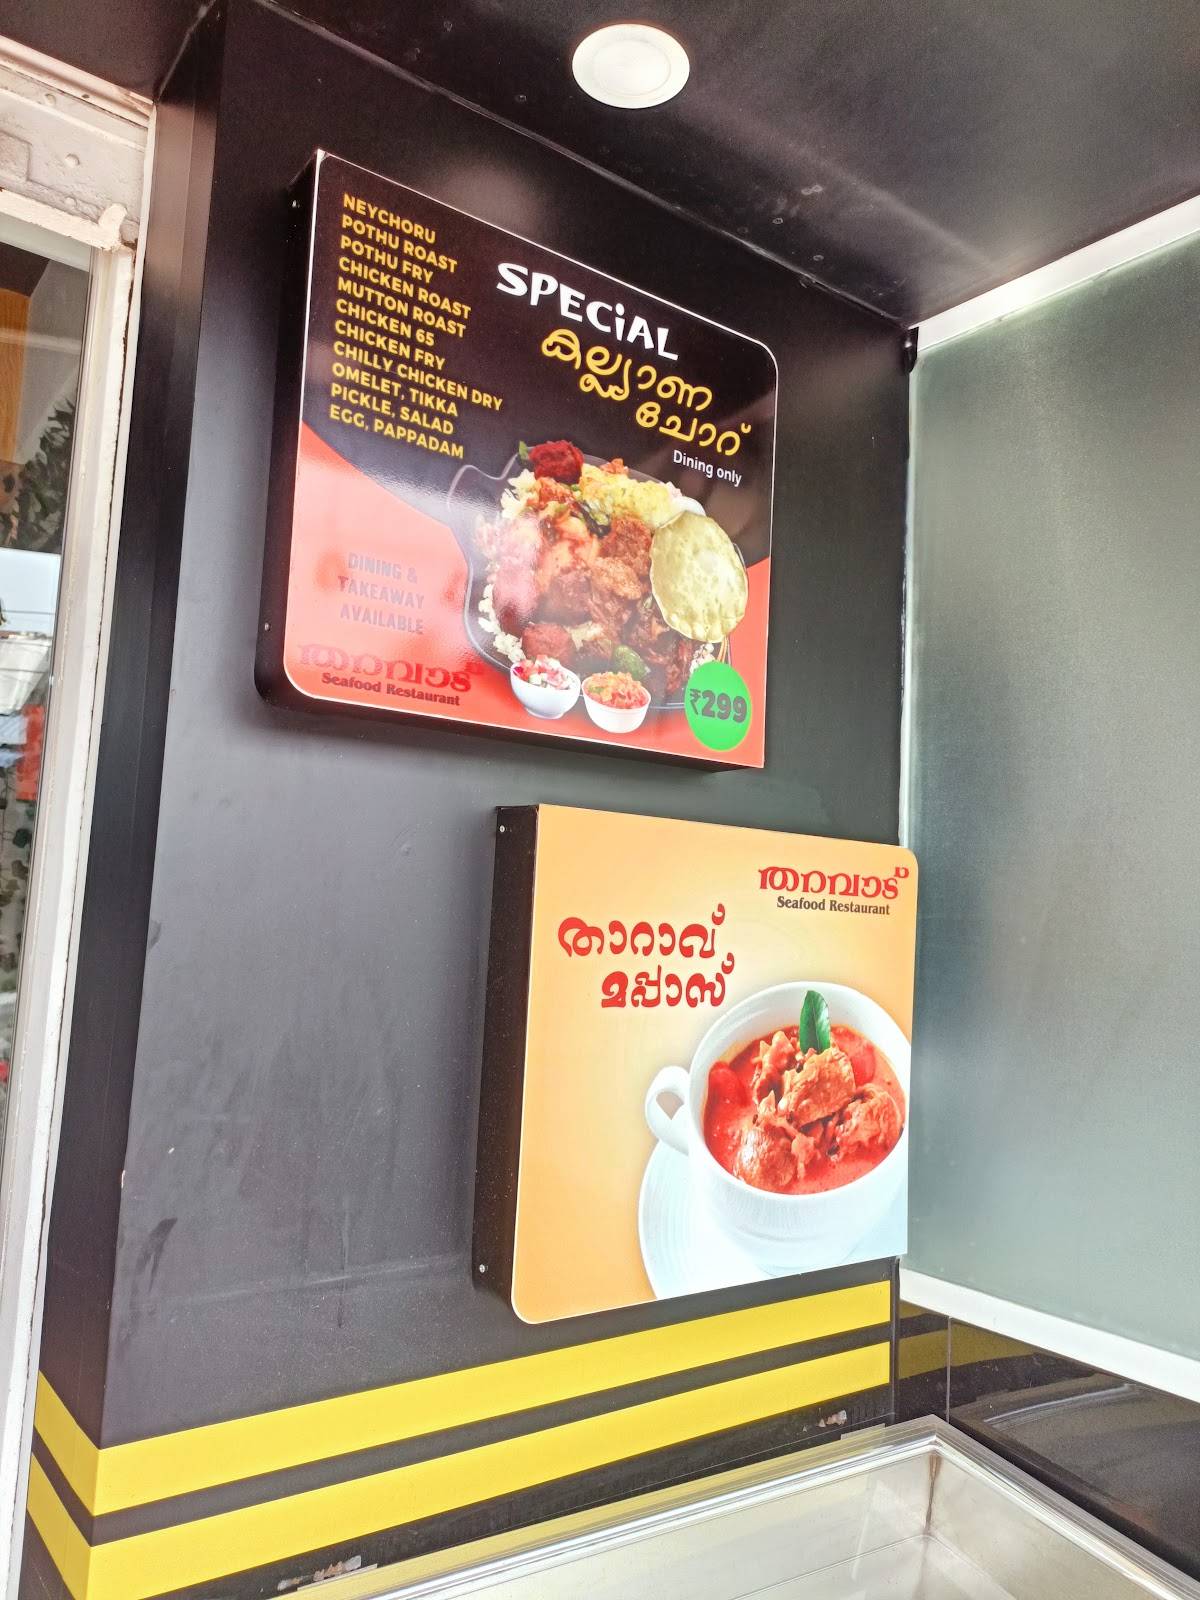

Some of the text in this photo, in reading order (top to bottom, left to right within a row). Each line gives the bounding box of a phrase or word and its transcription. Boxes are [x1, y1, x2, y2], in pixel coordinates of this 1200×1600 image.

[341, 214, 458, 273] POTHU ROAST
[343, 193, 436, 244] NEYCHORU
[340, 235, 434, 284] POTHU FRY
[337, 277, 467, 338] MUTTON ROAST
[338, 257, 472, 319] CHICKEN ROAST
[335, 299, 435, 347] CHICKEN 65
[335, 319, 446, 371] CHICKEN FRY
[332, 363, 459, 417] OMELET, TIKKA
[333, 340, 503, 411] CHILLY CHICKEN DRY
[329, 404, 465, 460] EGG, PAPPADAM
[330, 383, 454, 435] PICKLE, SALAD
[673, 449, 742, 488] Dining only
[337, 575, 425, 610] TAKEAWAY
[348, 552, 418, 584] DINING &
[340, 603, 424, 635] AVAILABLE
[321, 672, 461, 706] Seafood Restaurant
[689, 688, 748, 723] ₹299
[558, 903, 726, 959] താറാവ്
[776, 895, 890, 916] Seafood Restaurant
